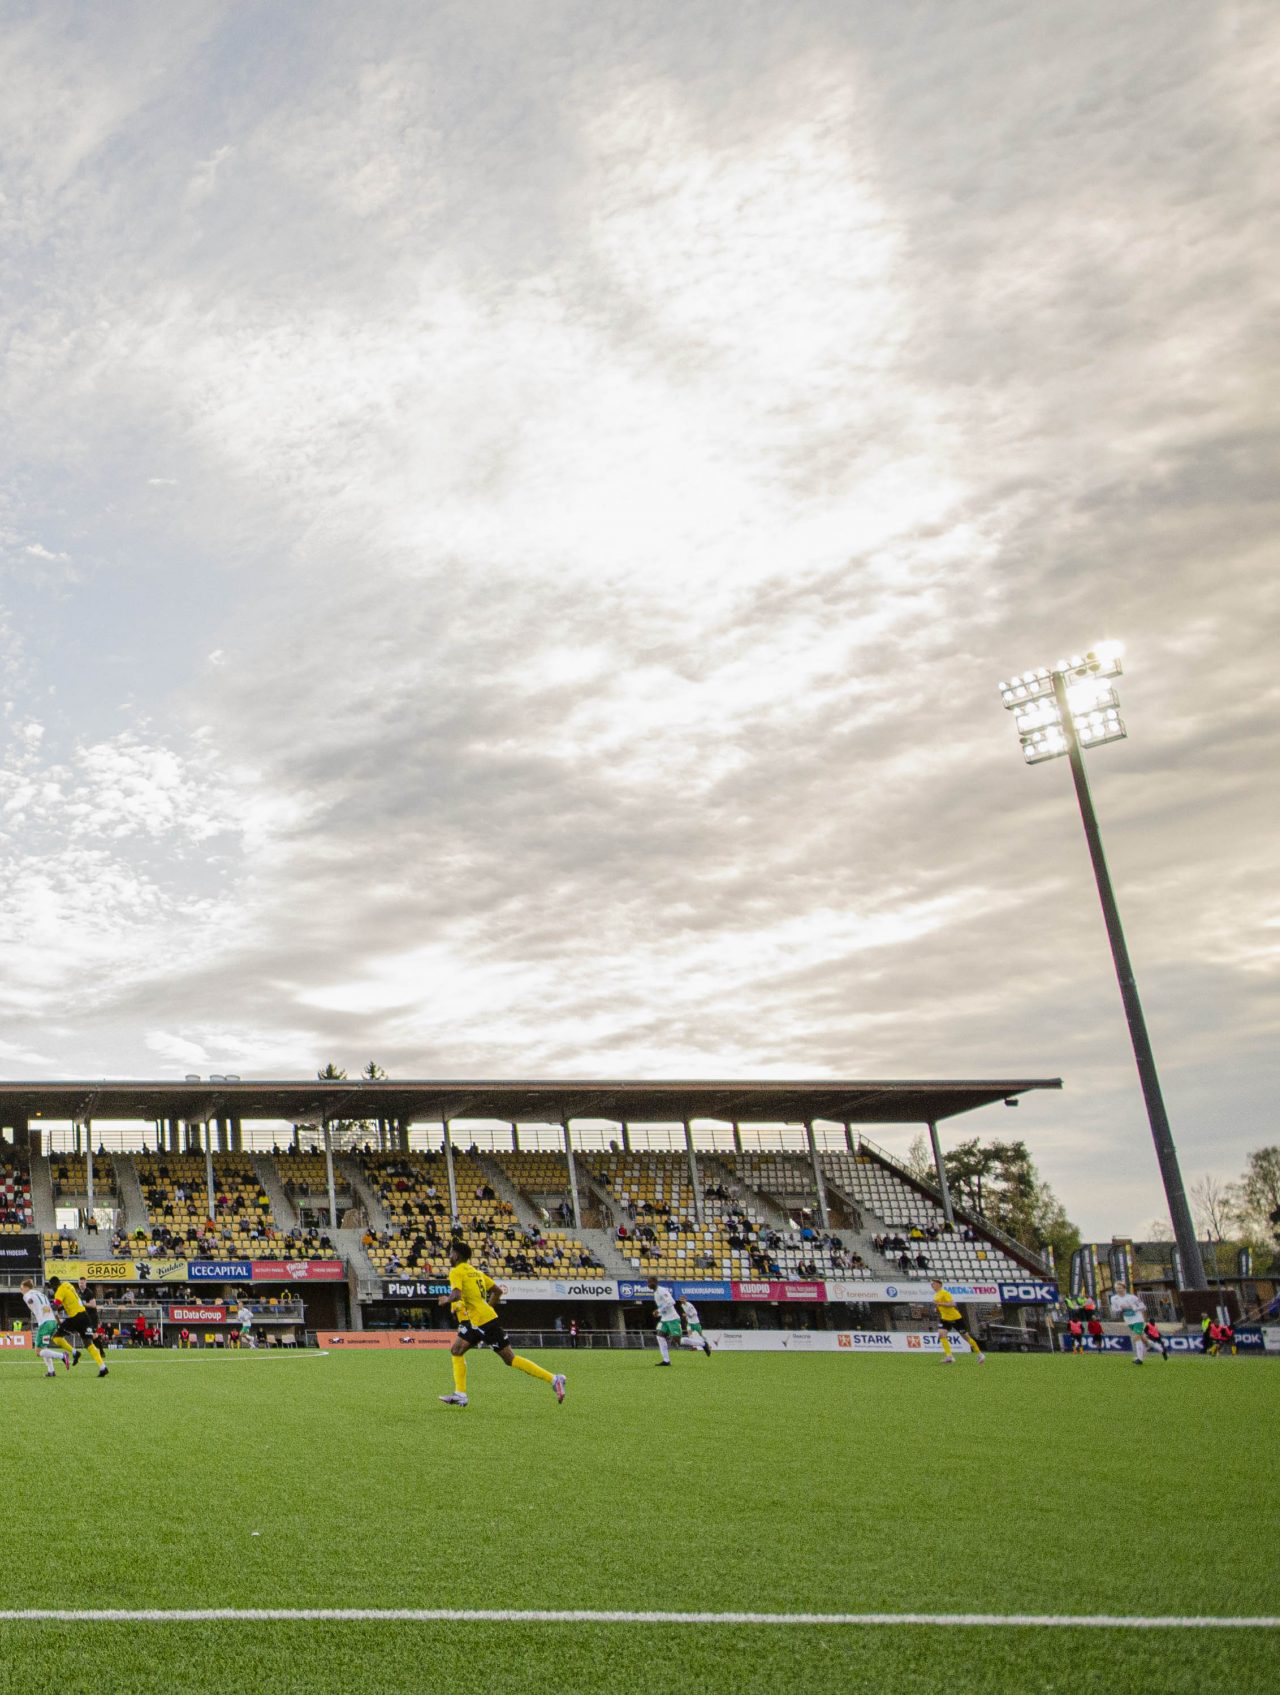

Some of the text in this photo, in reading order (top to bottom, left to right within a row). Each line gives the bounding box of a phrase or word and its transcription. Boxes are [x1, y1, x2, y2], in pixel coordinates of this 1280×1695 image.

[87, 1266, 126, 1275] GRANO
[191, 1266, 248, 1276] ICECAPITAL
[389, 1283, 452, 1297] Play it sma
[568, 1284, 613, 1296] sakupe
[740, 1283, 770, 1293] KUOPIO
[1003, 1286, 1053, 1300] POK
[183, 1310, 222, 1320] Data Group
[853, 1335, 892, 1344] STARK
[1234, 1334, 1260, 1343] POK
